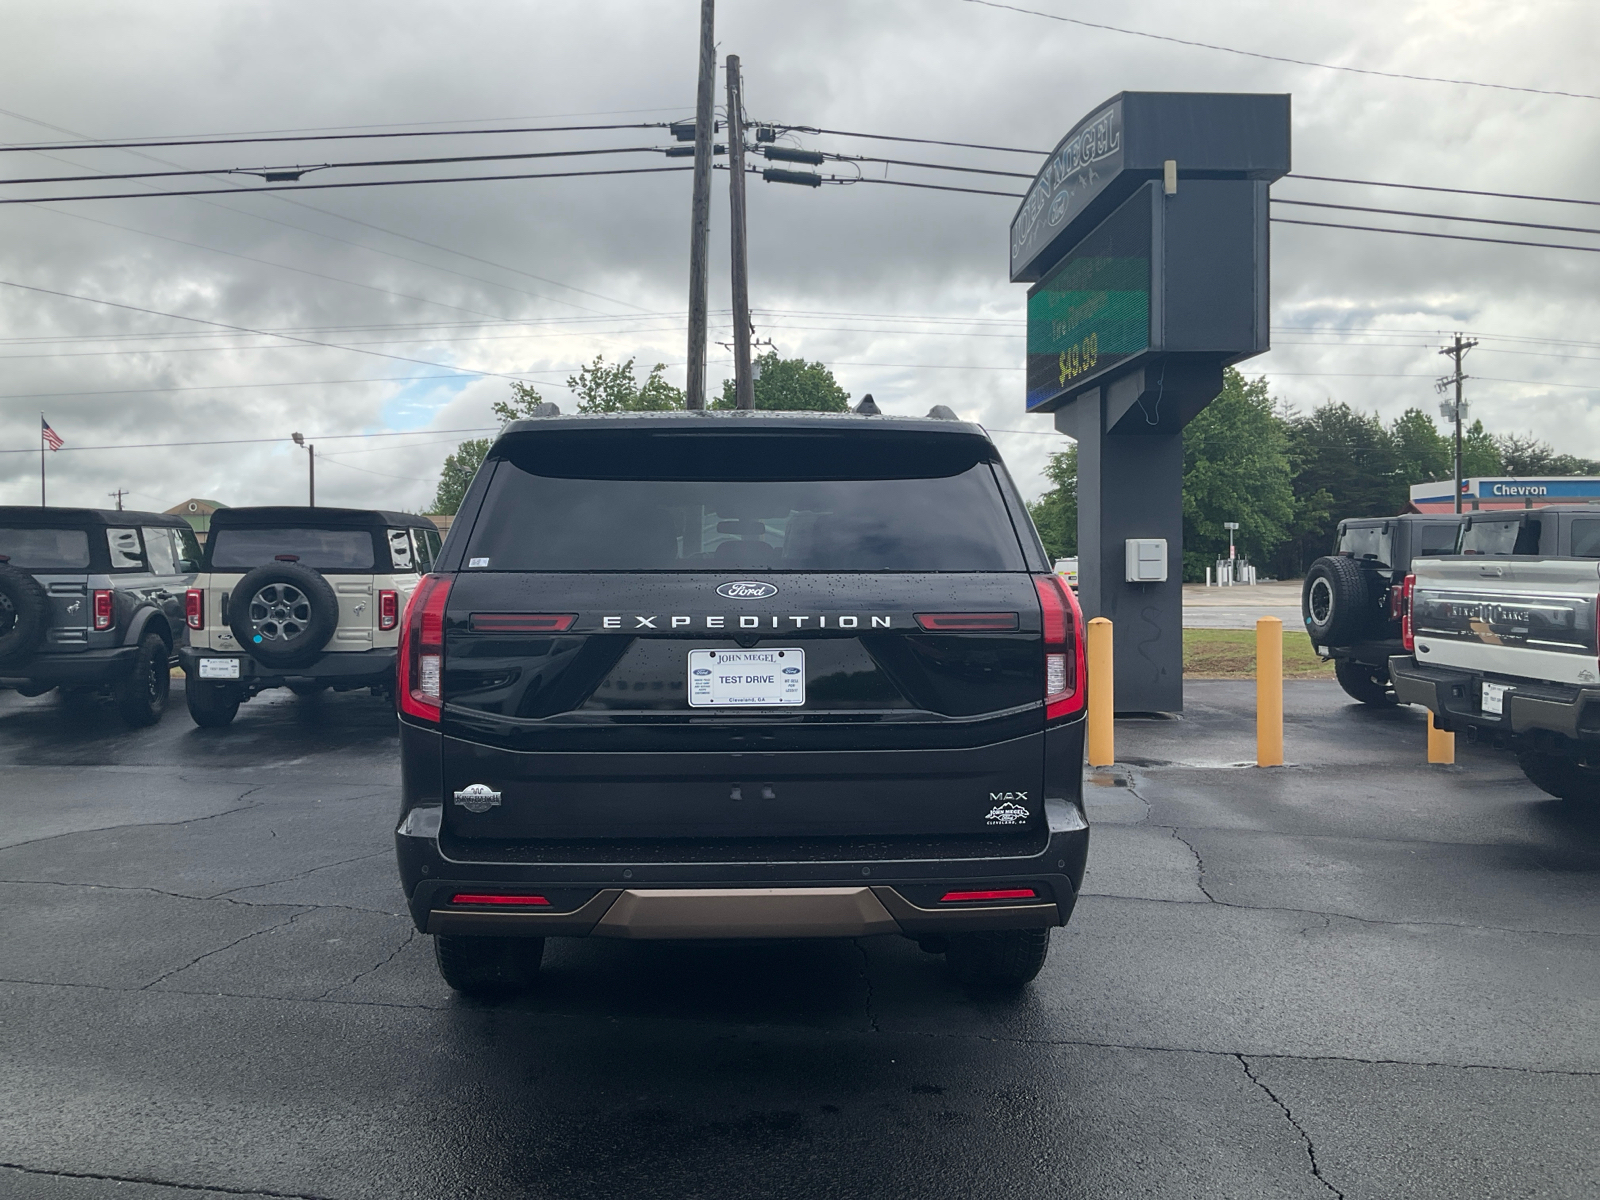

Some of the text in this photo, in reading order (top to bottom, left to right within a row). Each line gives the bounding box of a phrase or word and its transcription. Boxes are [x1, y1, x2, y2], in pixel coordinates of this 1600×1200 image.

[1012, 109, 1120, 258] JOHN MEGEL
[1059, 332, 1098, 387] $49.99
[1493, 484, 1547, 496] Chevron
[603, 615, 891, 630] EXPEDITION
[717, 654, 776, 664] JOHN MEGEL
[719, 676, 774, 684] TEST DRIVE
[990, 792, 1028, 800] MAX
